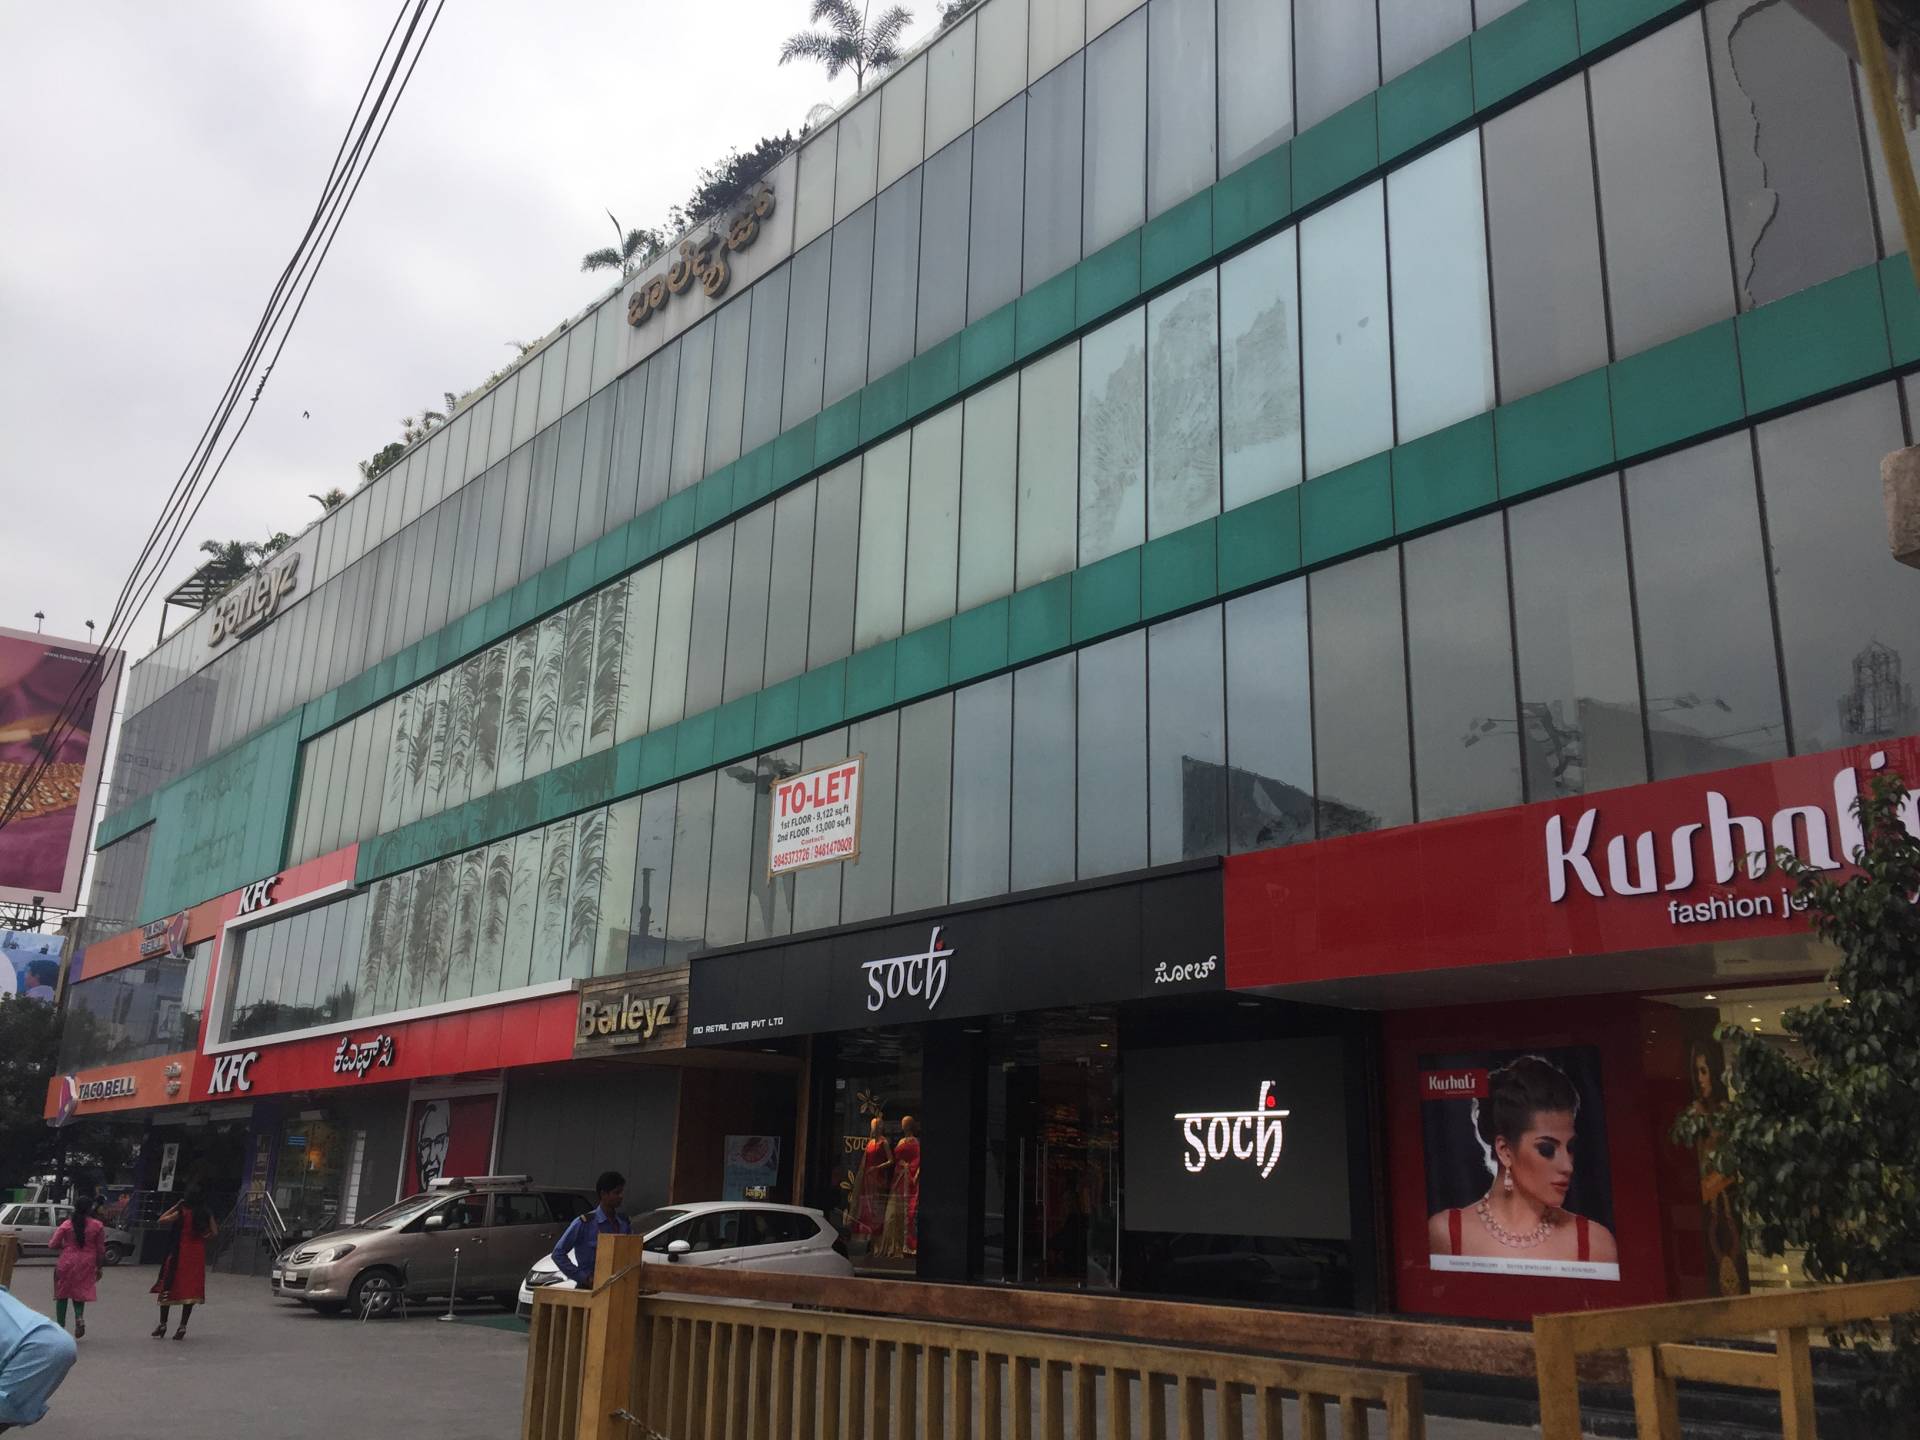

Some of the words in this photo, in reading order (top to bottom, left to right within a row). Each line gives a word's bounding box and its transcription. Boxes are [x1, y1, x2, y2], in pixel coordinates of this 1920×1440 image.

[207, 552, 300, 647] Barleyz
[779, 767, 856, 817] TO-LET
[789, 826, 810, 840] FLOOR
[791, 814, 812, 828] FLOOR
[236, 876, 278, 916] KFC
[1668, 894, 1773, 925] fashion
[582, 993, 671, 1038] Barleyz
[705, 1024, 729, 1033] RETAIL
[731, 1021, 749, 1030] INDIA
[751, 1019, 766, 1029] PVT
[768, 1016, 783, 1026] LTD
[79, 1081, 104, 1100] TACO
[104, 1077, 135, 1097] BELL
[208, 1052, 258, 1094] KFC
